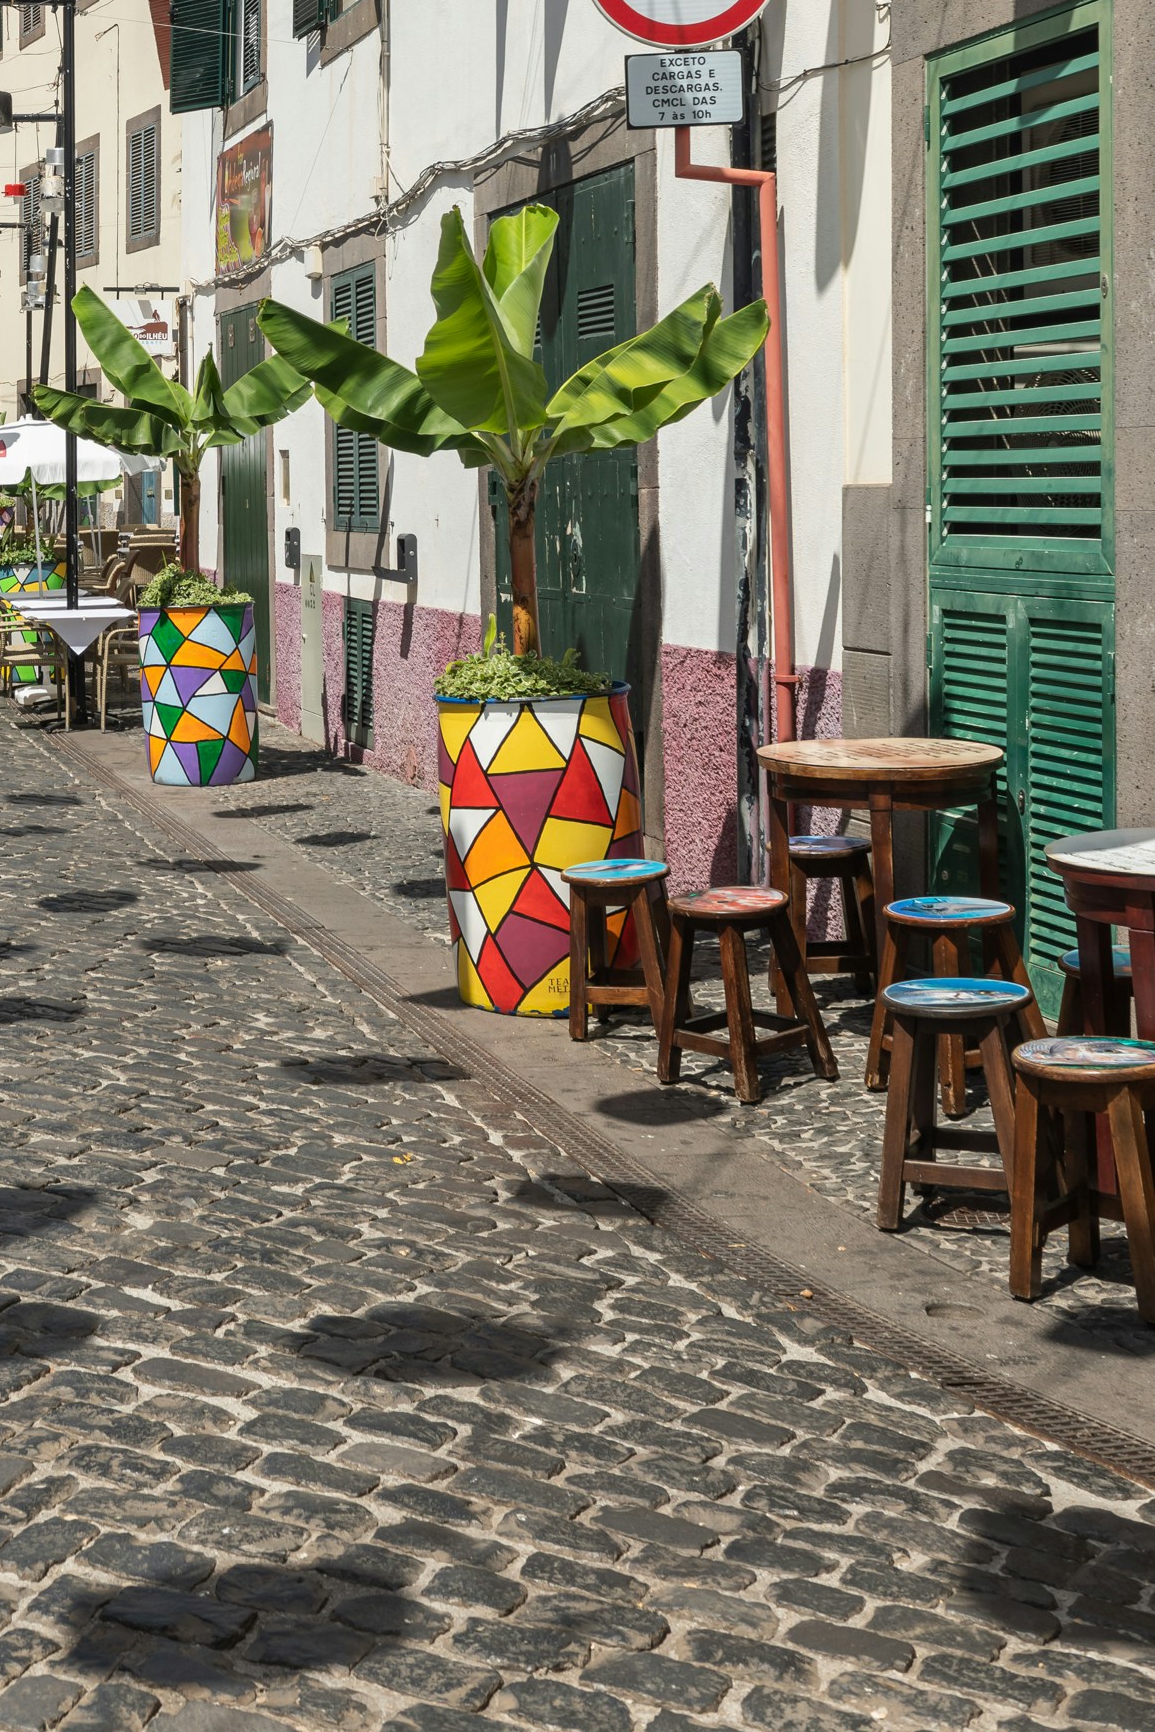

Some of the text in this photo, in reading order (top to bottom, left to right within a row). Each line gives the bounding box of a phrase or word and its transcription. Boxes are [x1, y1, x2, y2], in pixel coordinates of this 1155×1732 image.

[660, 56, 706, 68] EXCETO
[652, 69, 716, 81] CARGAS E
[645, 82, 723, 95] DESCARGAS.
[652, 96, 717, 108] CMCL DAS
[658, 109, 712, 121] 7 às 10h
